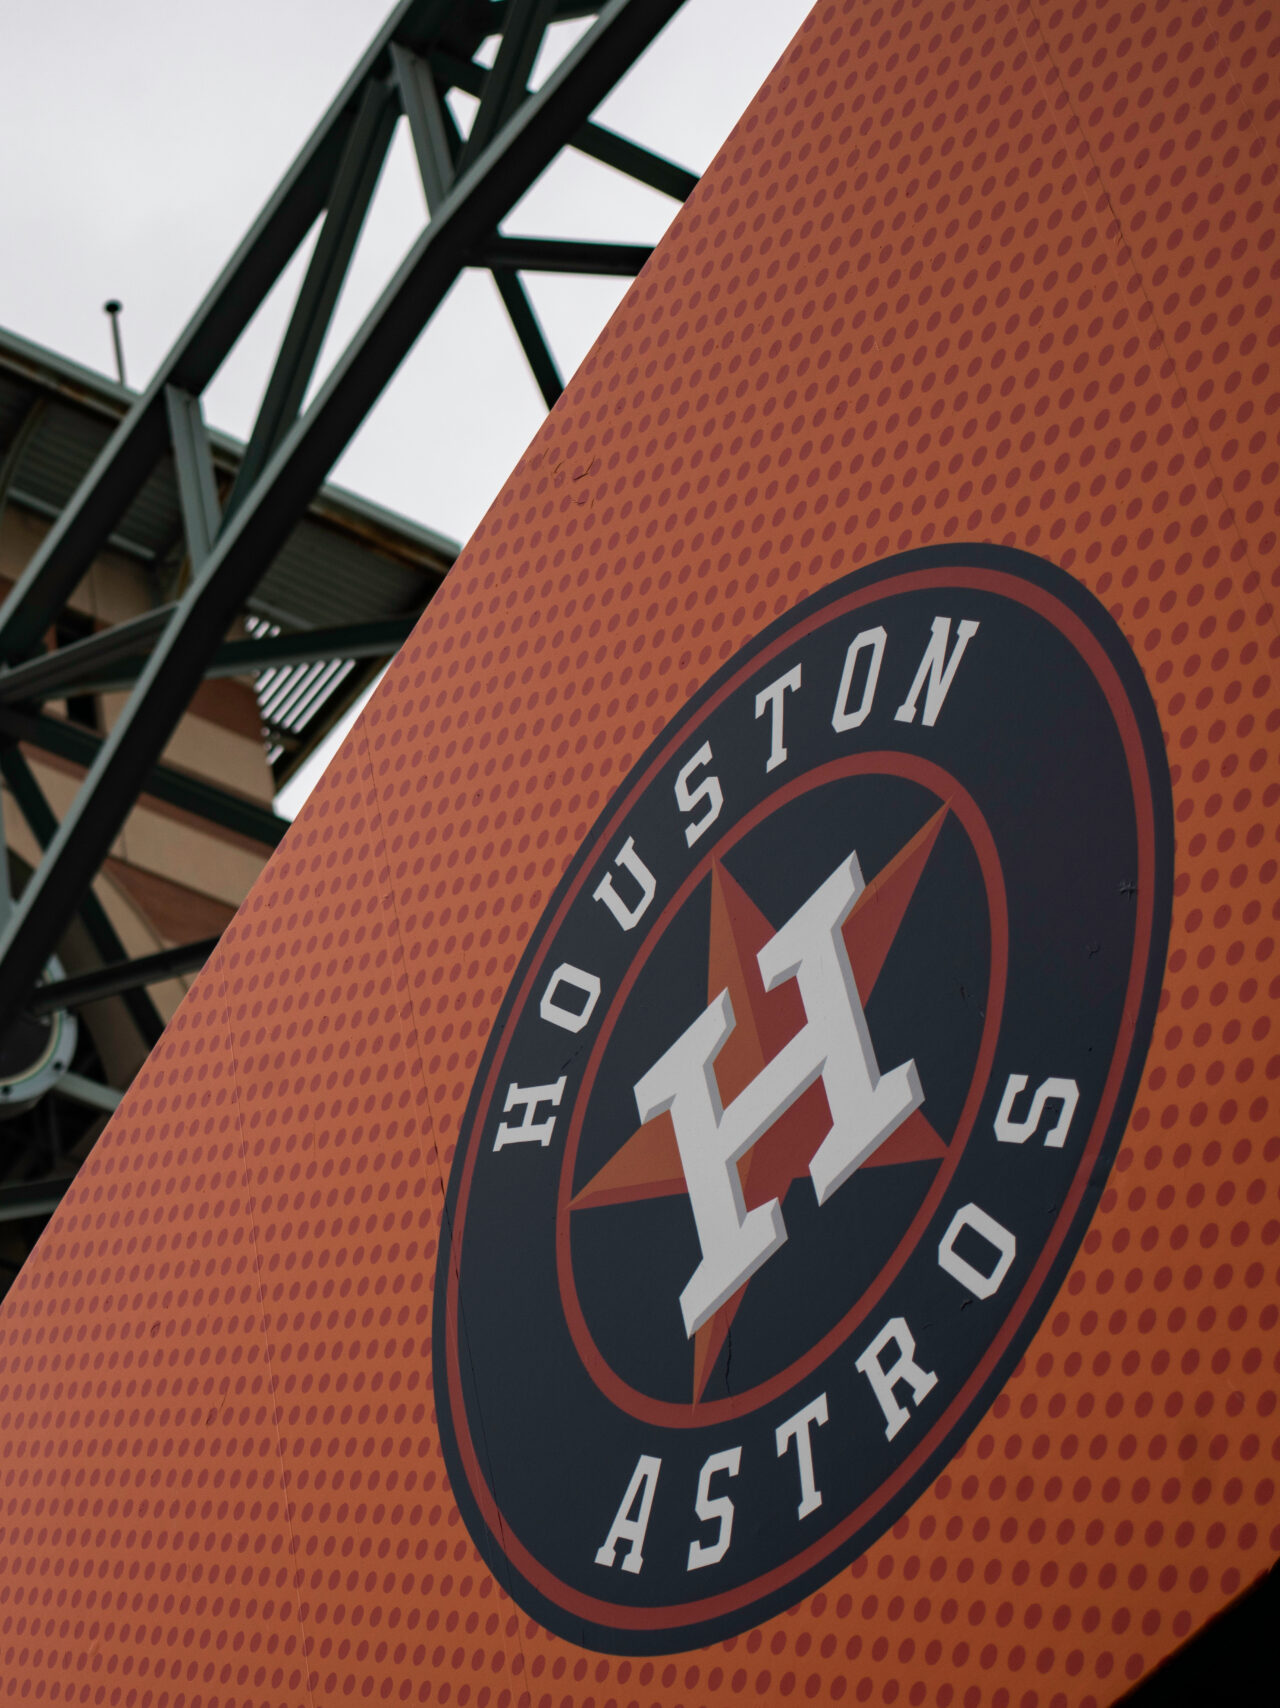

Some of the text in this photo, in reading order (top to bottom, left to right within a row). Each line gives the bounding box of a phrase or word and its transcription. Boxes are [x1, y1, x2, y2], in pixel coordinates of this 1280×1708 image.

[492, 616, 980, 1152] HOUSTON
[633, 849, 926, 1340] H
[594, 1073, 1080, 1575] ASTROS
